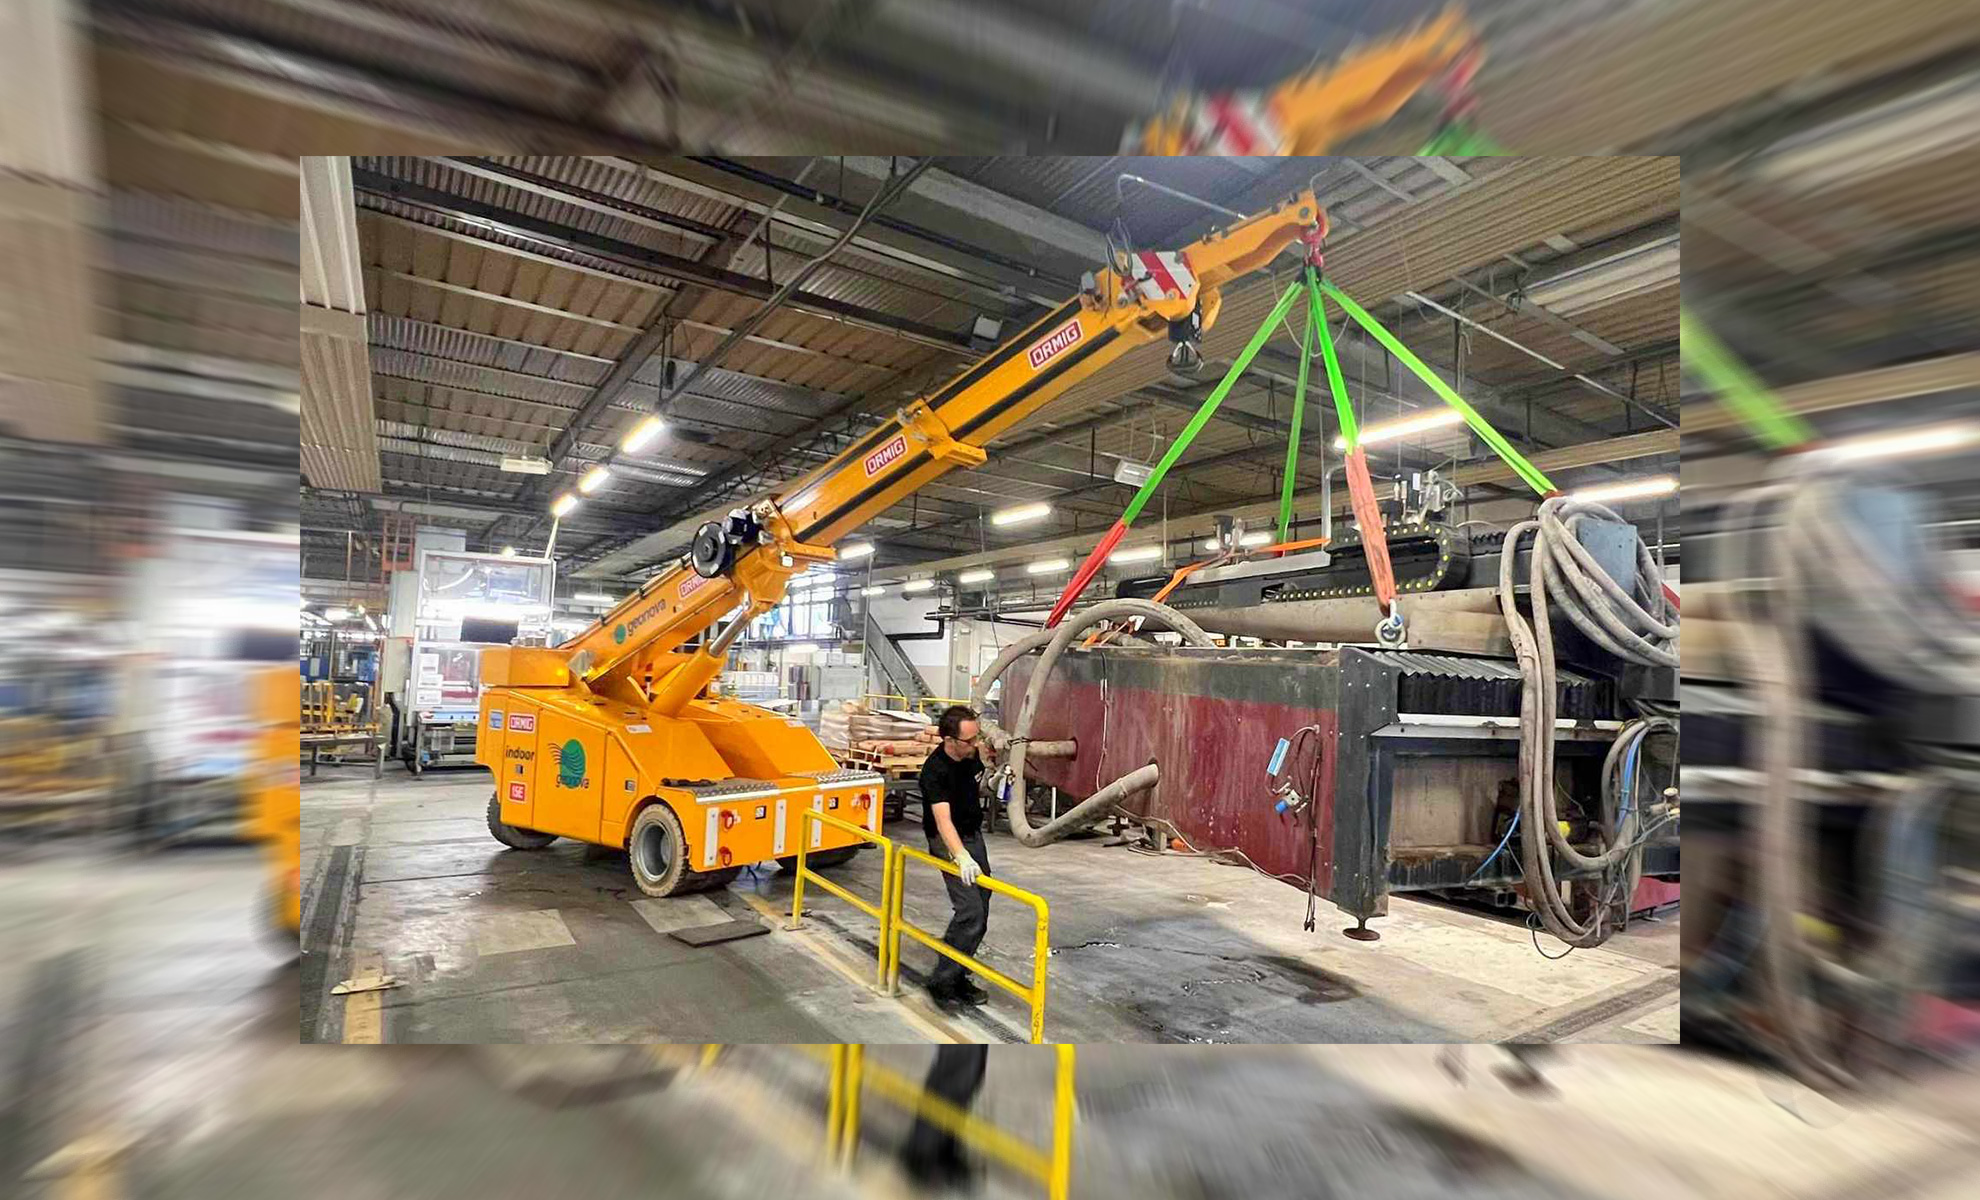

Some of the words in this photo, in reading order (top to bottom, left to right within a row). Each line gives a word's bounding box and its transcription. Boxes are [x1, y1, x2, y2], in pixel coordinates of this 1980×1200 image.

[1031, 324, 1078, 365] ORMIG
[867, 439, 904, 473] ORMIG
[505, 745, 535, 761] indoor
